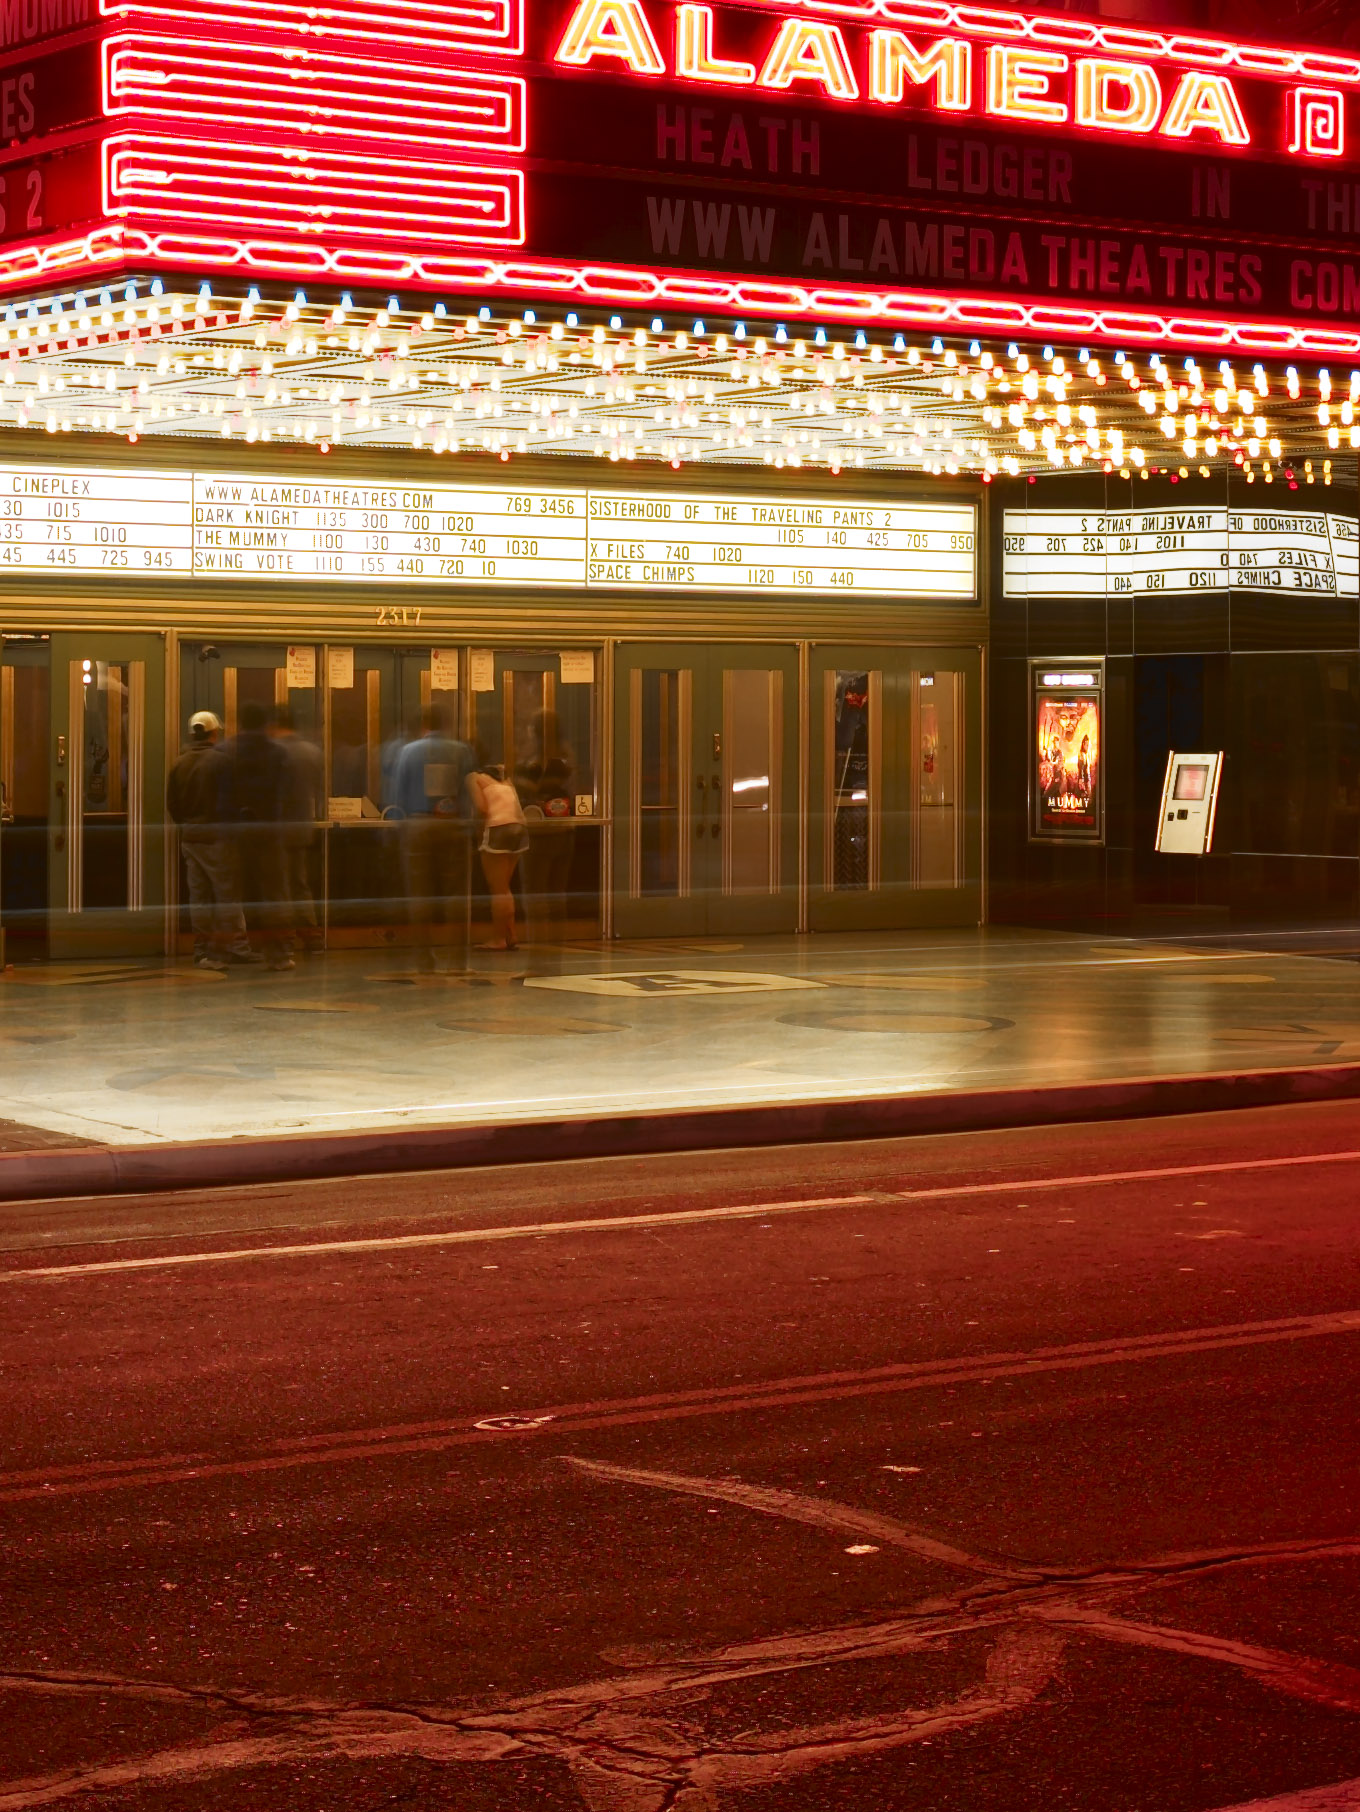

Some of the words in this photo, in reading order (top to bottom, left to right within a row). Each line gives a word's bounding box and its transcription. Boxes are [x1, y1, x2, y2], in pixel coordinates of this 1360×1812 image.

[656, 104, 820, 175] HEATH
[907, 135, 1073, 204] LEDGER
[1191, 167, 1231, 219] IN
[27, 171, 42, 230] 2
[646, 197, 776, 262] WWW
[13, 476, 90, 495] CINEPLEX
[48, 502, 80, 518] 1015
[205, 486, 242, 501] WWW
[251, 487, 397, 508] ALAMEDATHEATRES
[403, 493, 433, 508] COM
[506, 497, 532, 512] 769
[540, 498, 575, 515] 3456
[195, 508, 234, 523] DARK
[246, 510, 299, 525] KNIGHT
[317, 512, 347, 527] 1135
[362, 513, 388, 529] 300
[404, 515, 430, 530] 700
[442, 516, 474, 532] 1020
[589, 500, 671, 519] SISTERHOOD
[684, 504, 700, 519] OF
[714, 506, 738, 521] THE
[752, 507, 822, 524] TRAVELING
[833, 510, 873, 526] PANTS
[884, 512, 892, 527] 2
[47, 525, 72, 540] 715
[95, 527, 127, 543] 1010
[195, 530, 222, 545] THE
[229, 531, 288, 547] MUMMY
[313, 534, 343, 549] 1100
[366, 536, 389, 551] 130
[414, 537, 440, 552] 430
[461, 539, 486, 554] 740
[506, 540, 538, 556] 1030
[778, 528, 804, 543] 1105
[826, 531, 847, 545] 140
[866, 532, 889, 547] 425
[907, 533, 928, 548] 705
[950, 535, 973, 549] 950
[47, 548, 76, 564] 445
[101, 550, 128, 566] 725
[143, 551, 173, 567] 945
[194, 551, 243, 569] SWING
[257, 554, 294, 570] VOTE
[316, 557, 343, 571] 1110
[362, 557, 385, 572] 155
[397, 558, 423, 573] 440
[439, 559, 464, 575] 720
[482, 560, 496, 576] 10
[590, 542, 598, 558] X
[607, 543, 645, 559] FILES
[665, 545, 690, 560] 740
[713, 547, 742, 562] 1020
[589, 563, 632, 580] SPACE
[643, 565, 695, 582] CHIMPS
[748, 568, 774, 584] 1120
[792, 570, 813, 585] 150
[830, 571, 854, 586] 440
[375, 606, 423, 626] 2317
